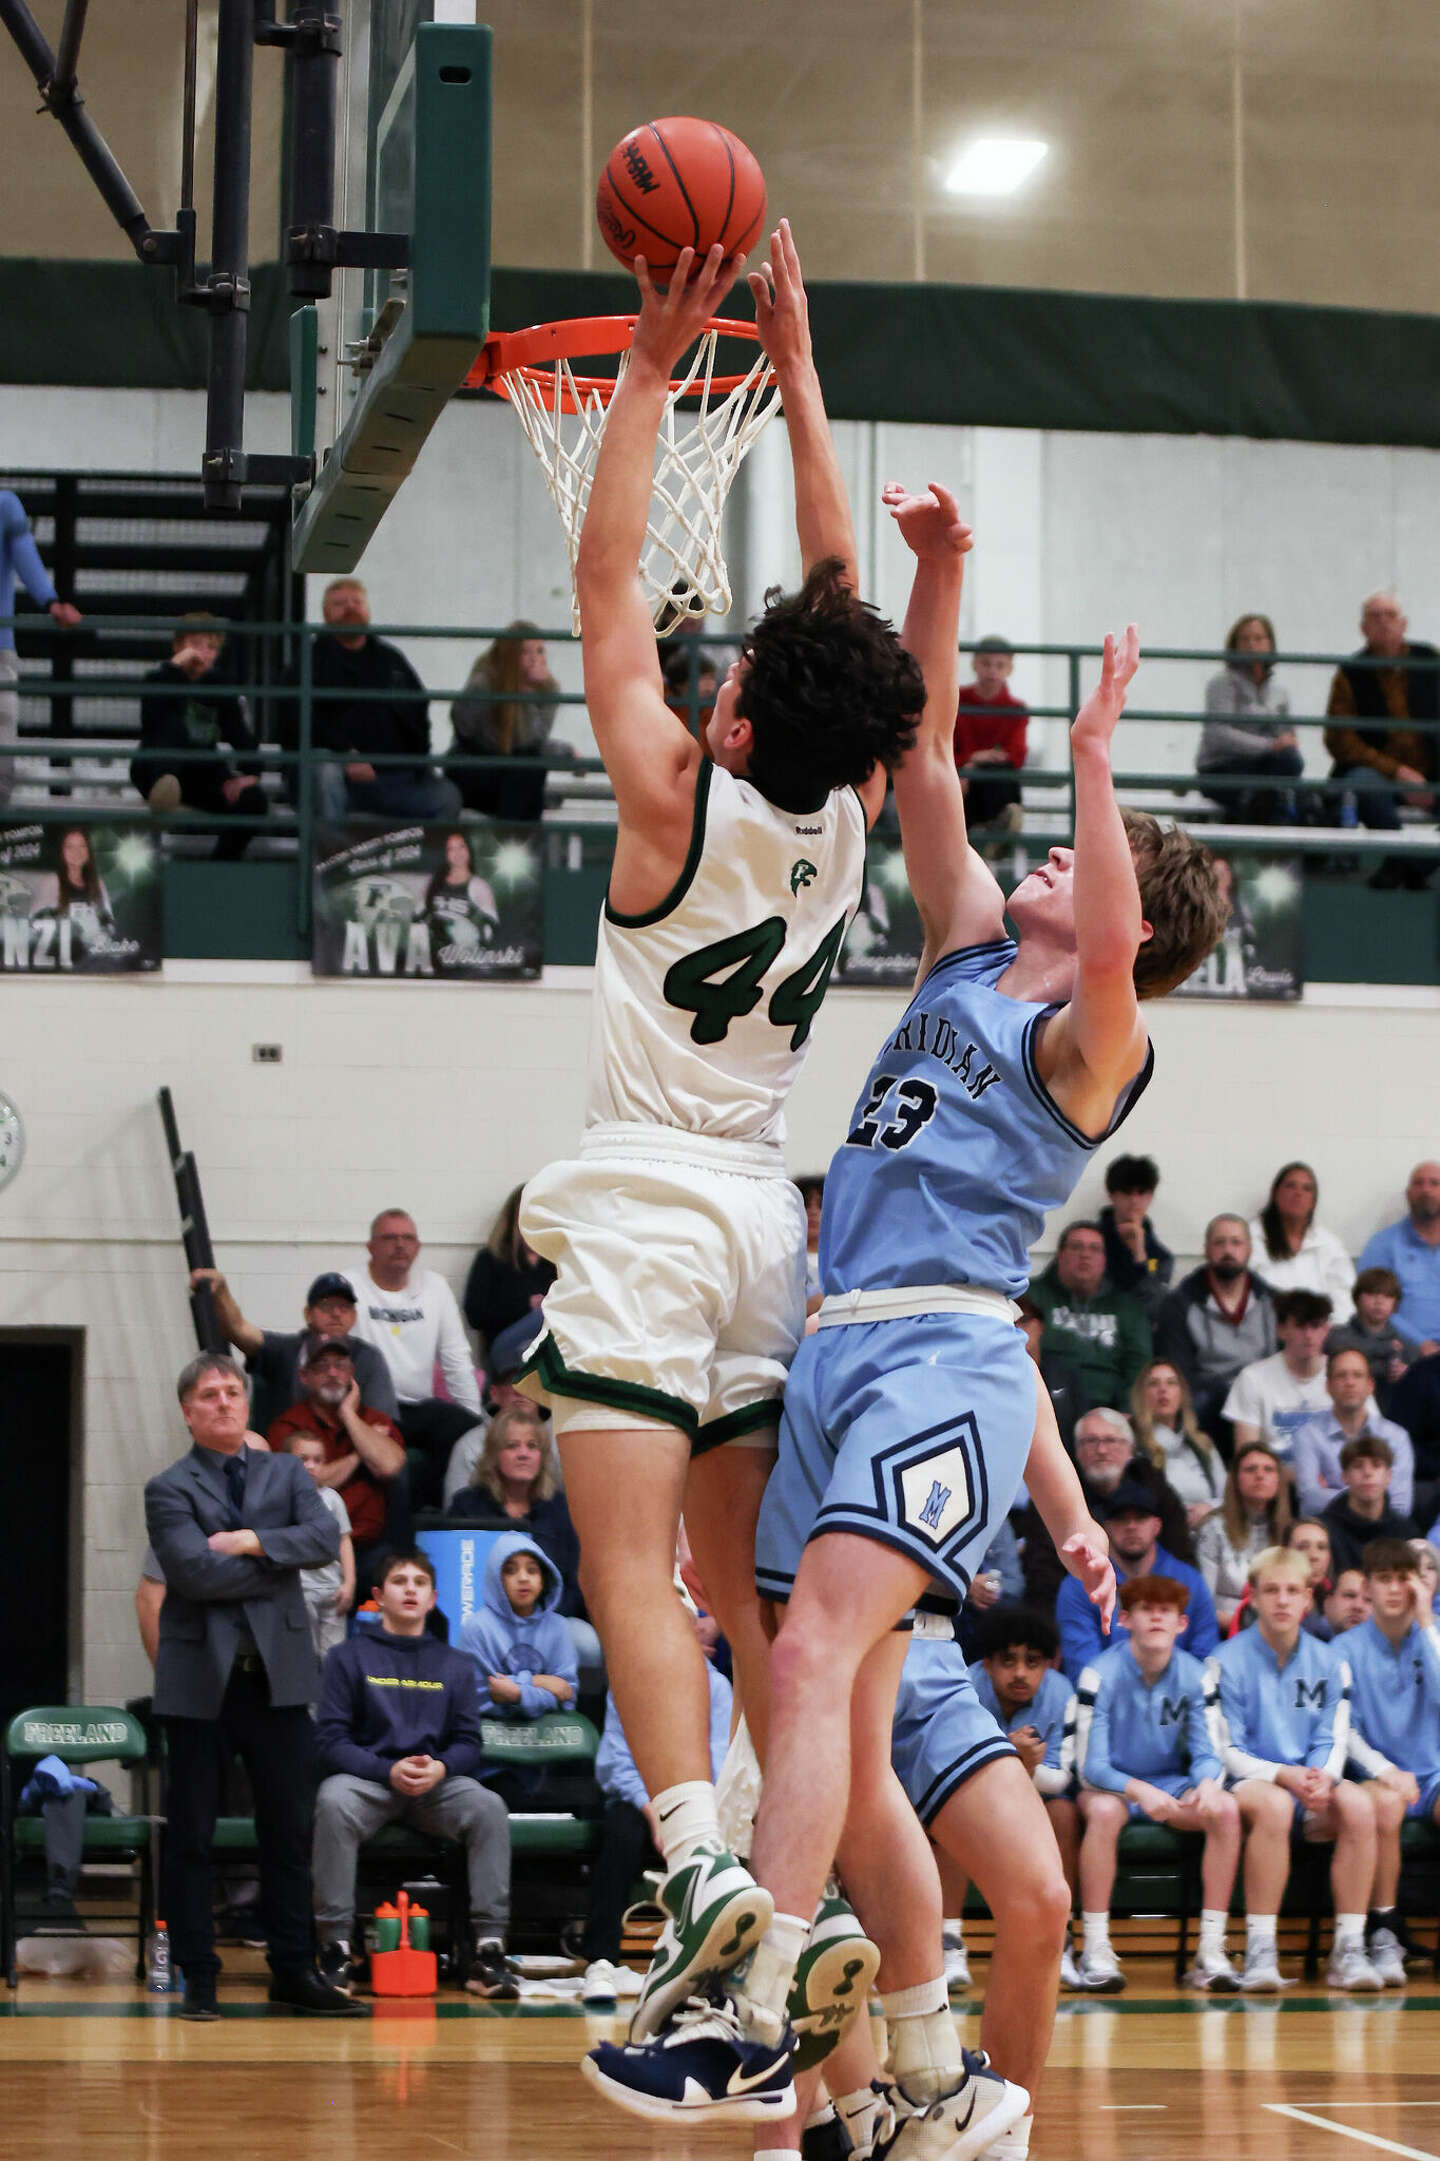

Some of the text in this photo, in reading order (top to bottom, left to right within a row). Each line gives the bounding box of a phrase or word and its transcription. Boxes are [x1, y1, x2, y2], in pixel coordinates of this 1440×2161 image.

[343, 920, 434, 973] AVA
[663, 915, 848, 1053] 44
[884, 1011, 1002, 1099] RIDIAN
[845, 1074, 940, 1151] 23
[919, 1480, 952, 1530] M
[1160, 1695, 1192, 1726] M
[1294, 1677, 1329, 1709] M
[23, 1722, 128, 1744] FREELAND
